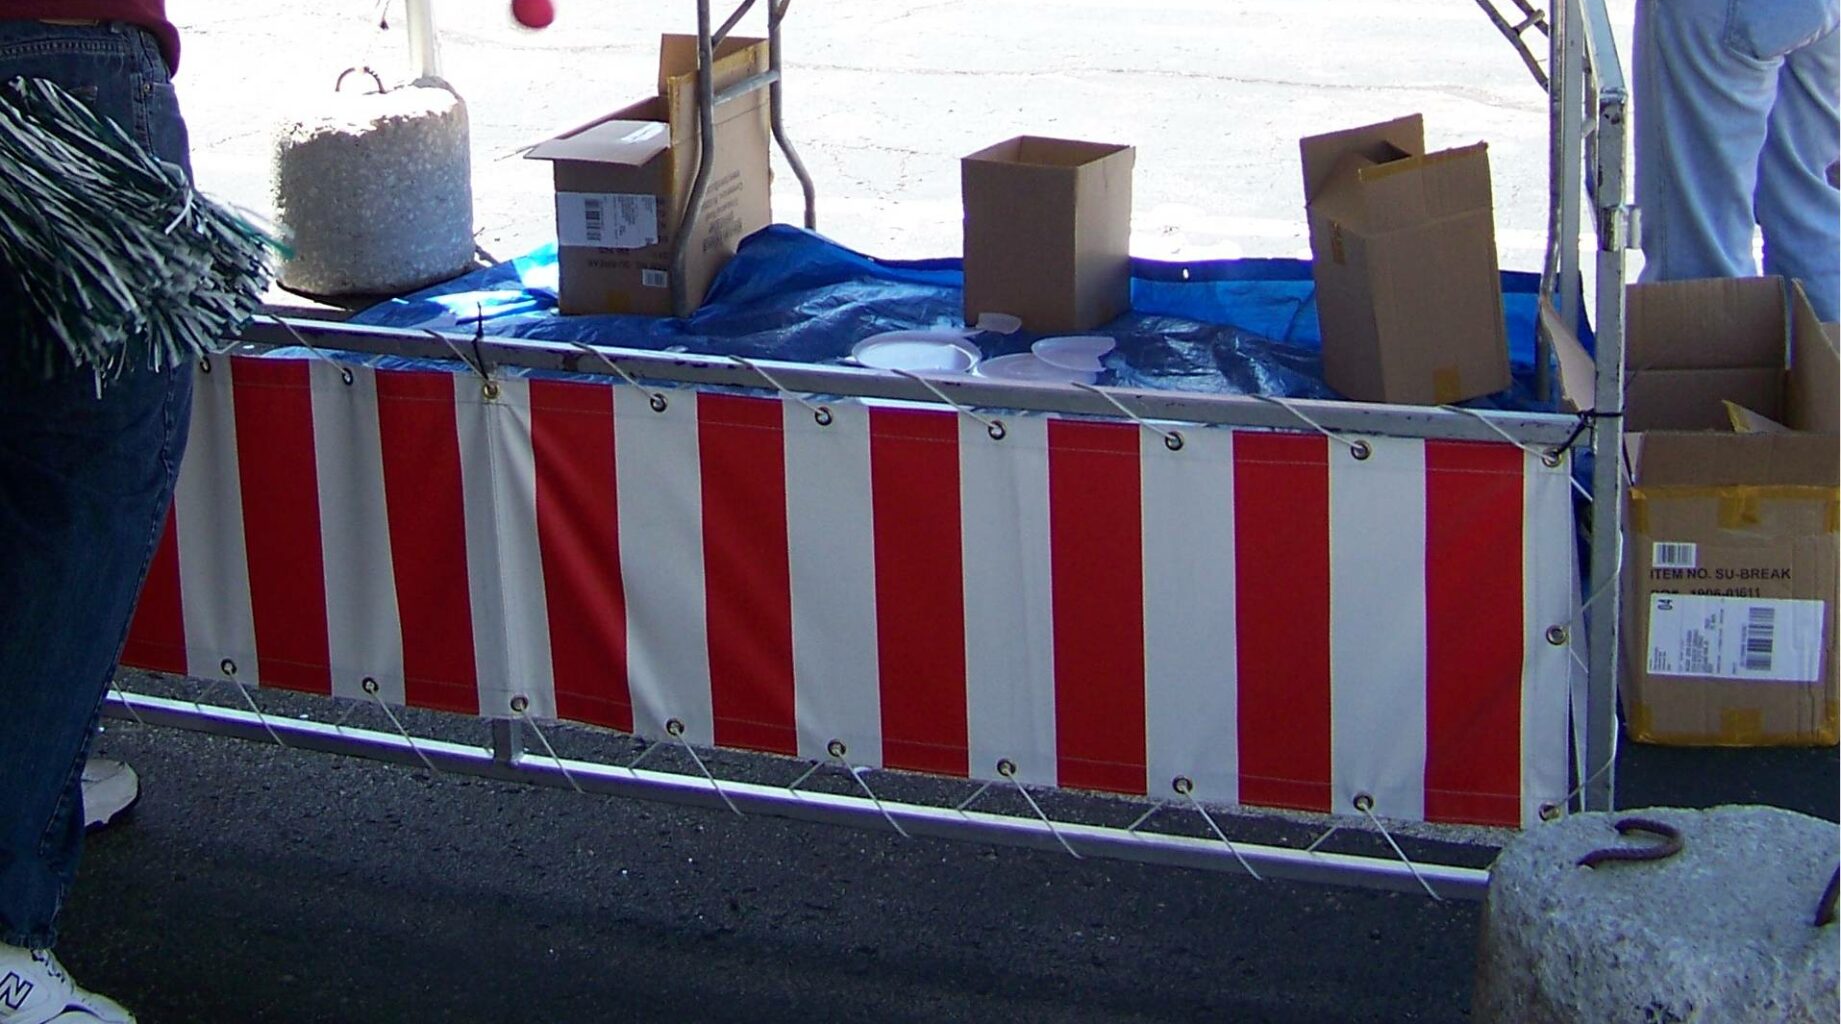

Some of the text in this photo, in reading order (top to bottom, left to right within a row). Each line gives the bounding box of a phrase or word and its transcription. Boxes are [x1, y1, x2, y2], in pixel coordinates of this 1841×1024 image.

[1650, 568, 1791, 580] ITEM NO. SU-BREAK
[0, 971, 34, 1010] N
